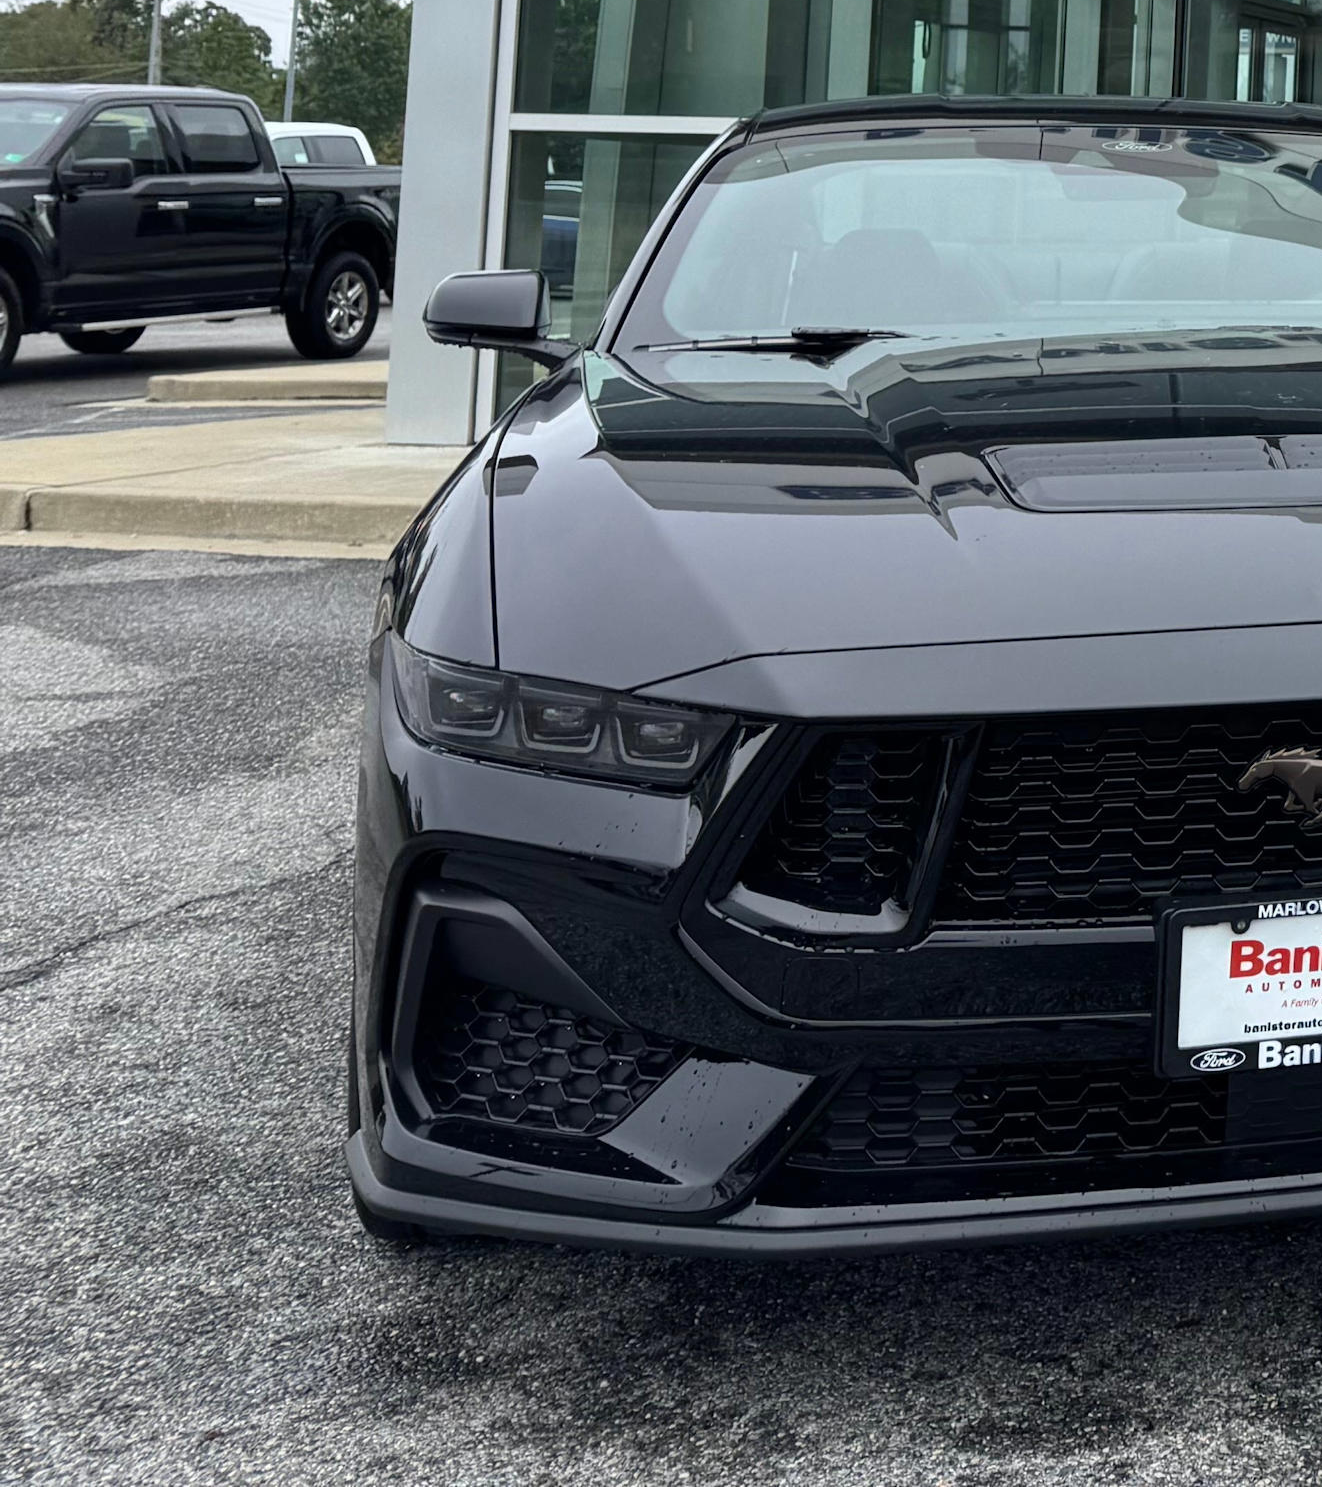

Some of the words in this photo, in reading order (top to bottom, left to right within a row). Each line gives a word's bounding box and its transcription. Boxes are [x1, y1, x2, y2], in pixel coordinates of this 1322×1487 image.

[1281, 999, 1289, 1009] A
[1290, 997, 1319, 1009] Family
[1198, 1050, 1239, 1070] Ford
